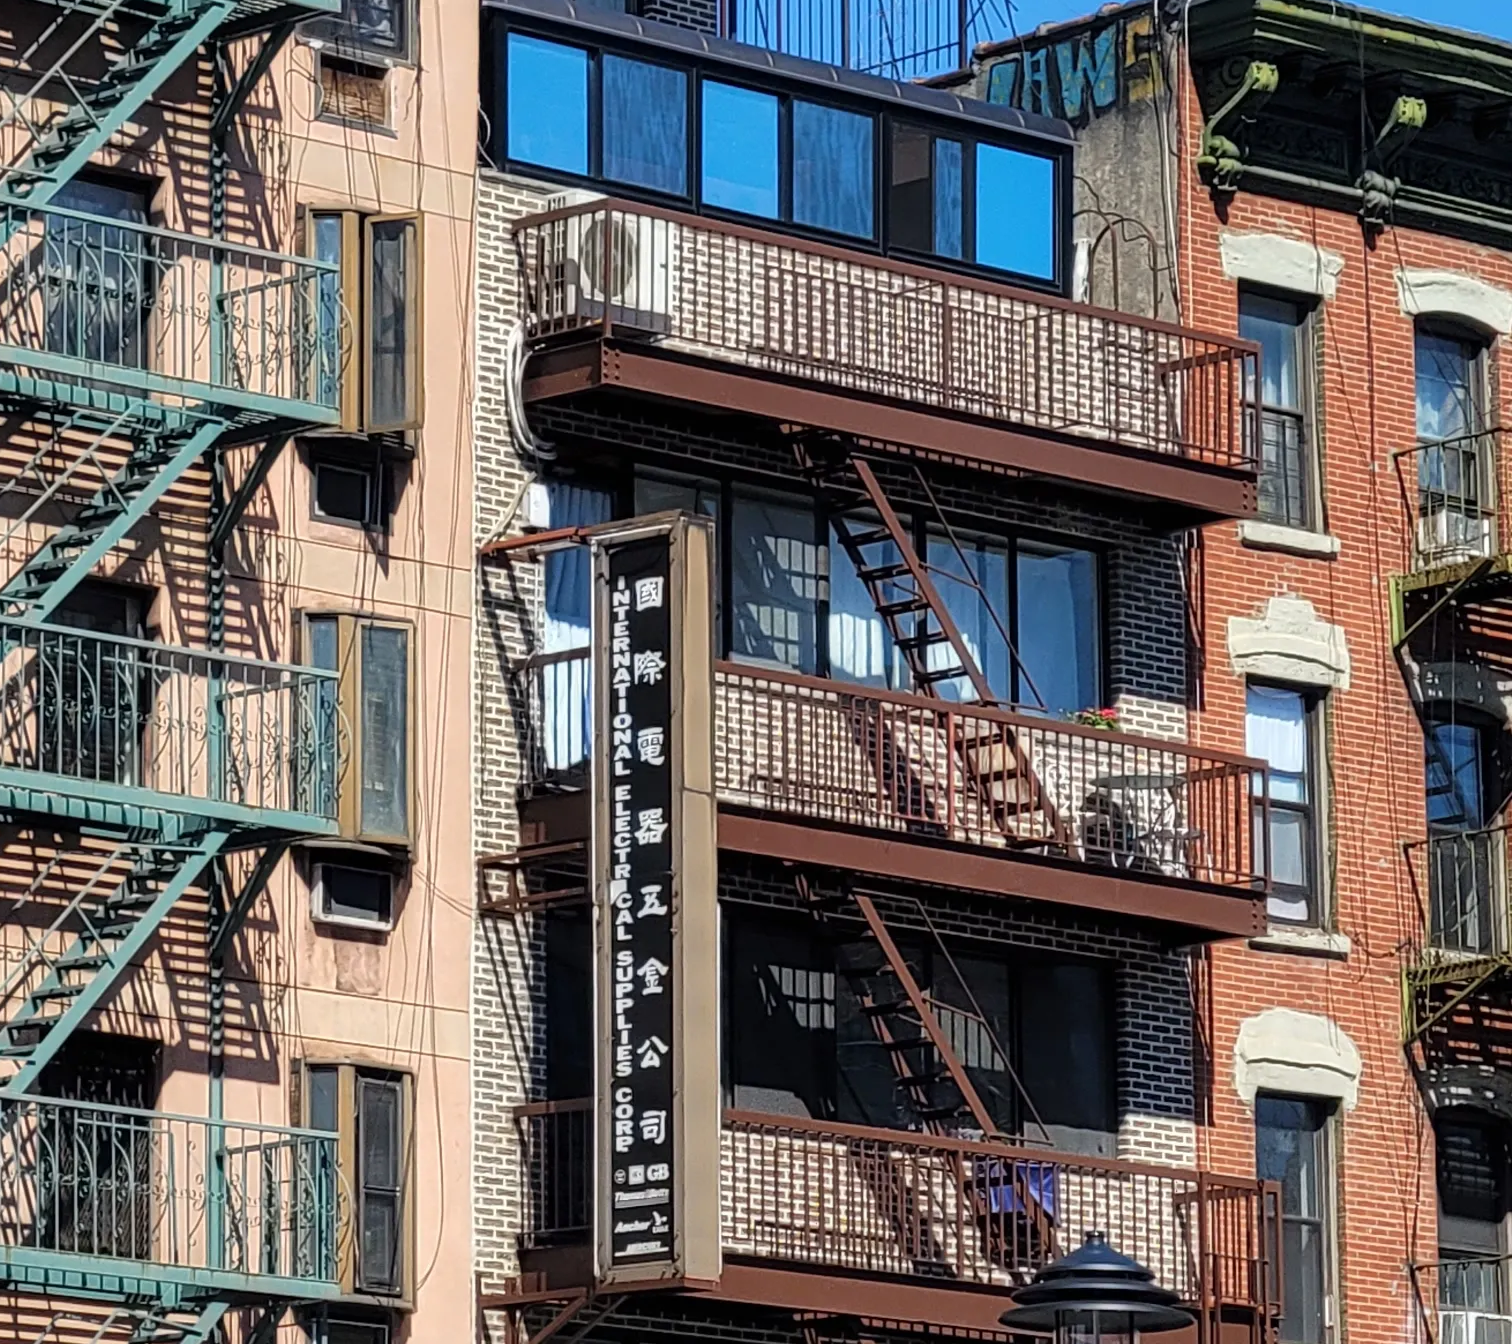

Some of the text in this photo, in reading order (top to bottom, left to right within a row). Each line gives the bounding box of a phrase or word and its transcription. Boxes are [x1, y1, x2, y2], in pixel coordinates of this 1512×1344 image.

[613, 575, 633, 777] INTERNATIONAL
[613, 785, 634, 941] ELECTRCAL
[634, 576, 669, 1145] 國際電器五金公司
[615, 950, 634, 1077] SUPPLIES
